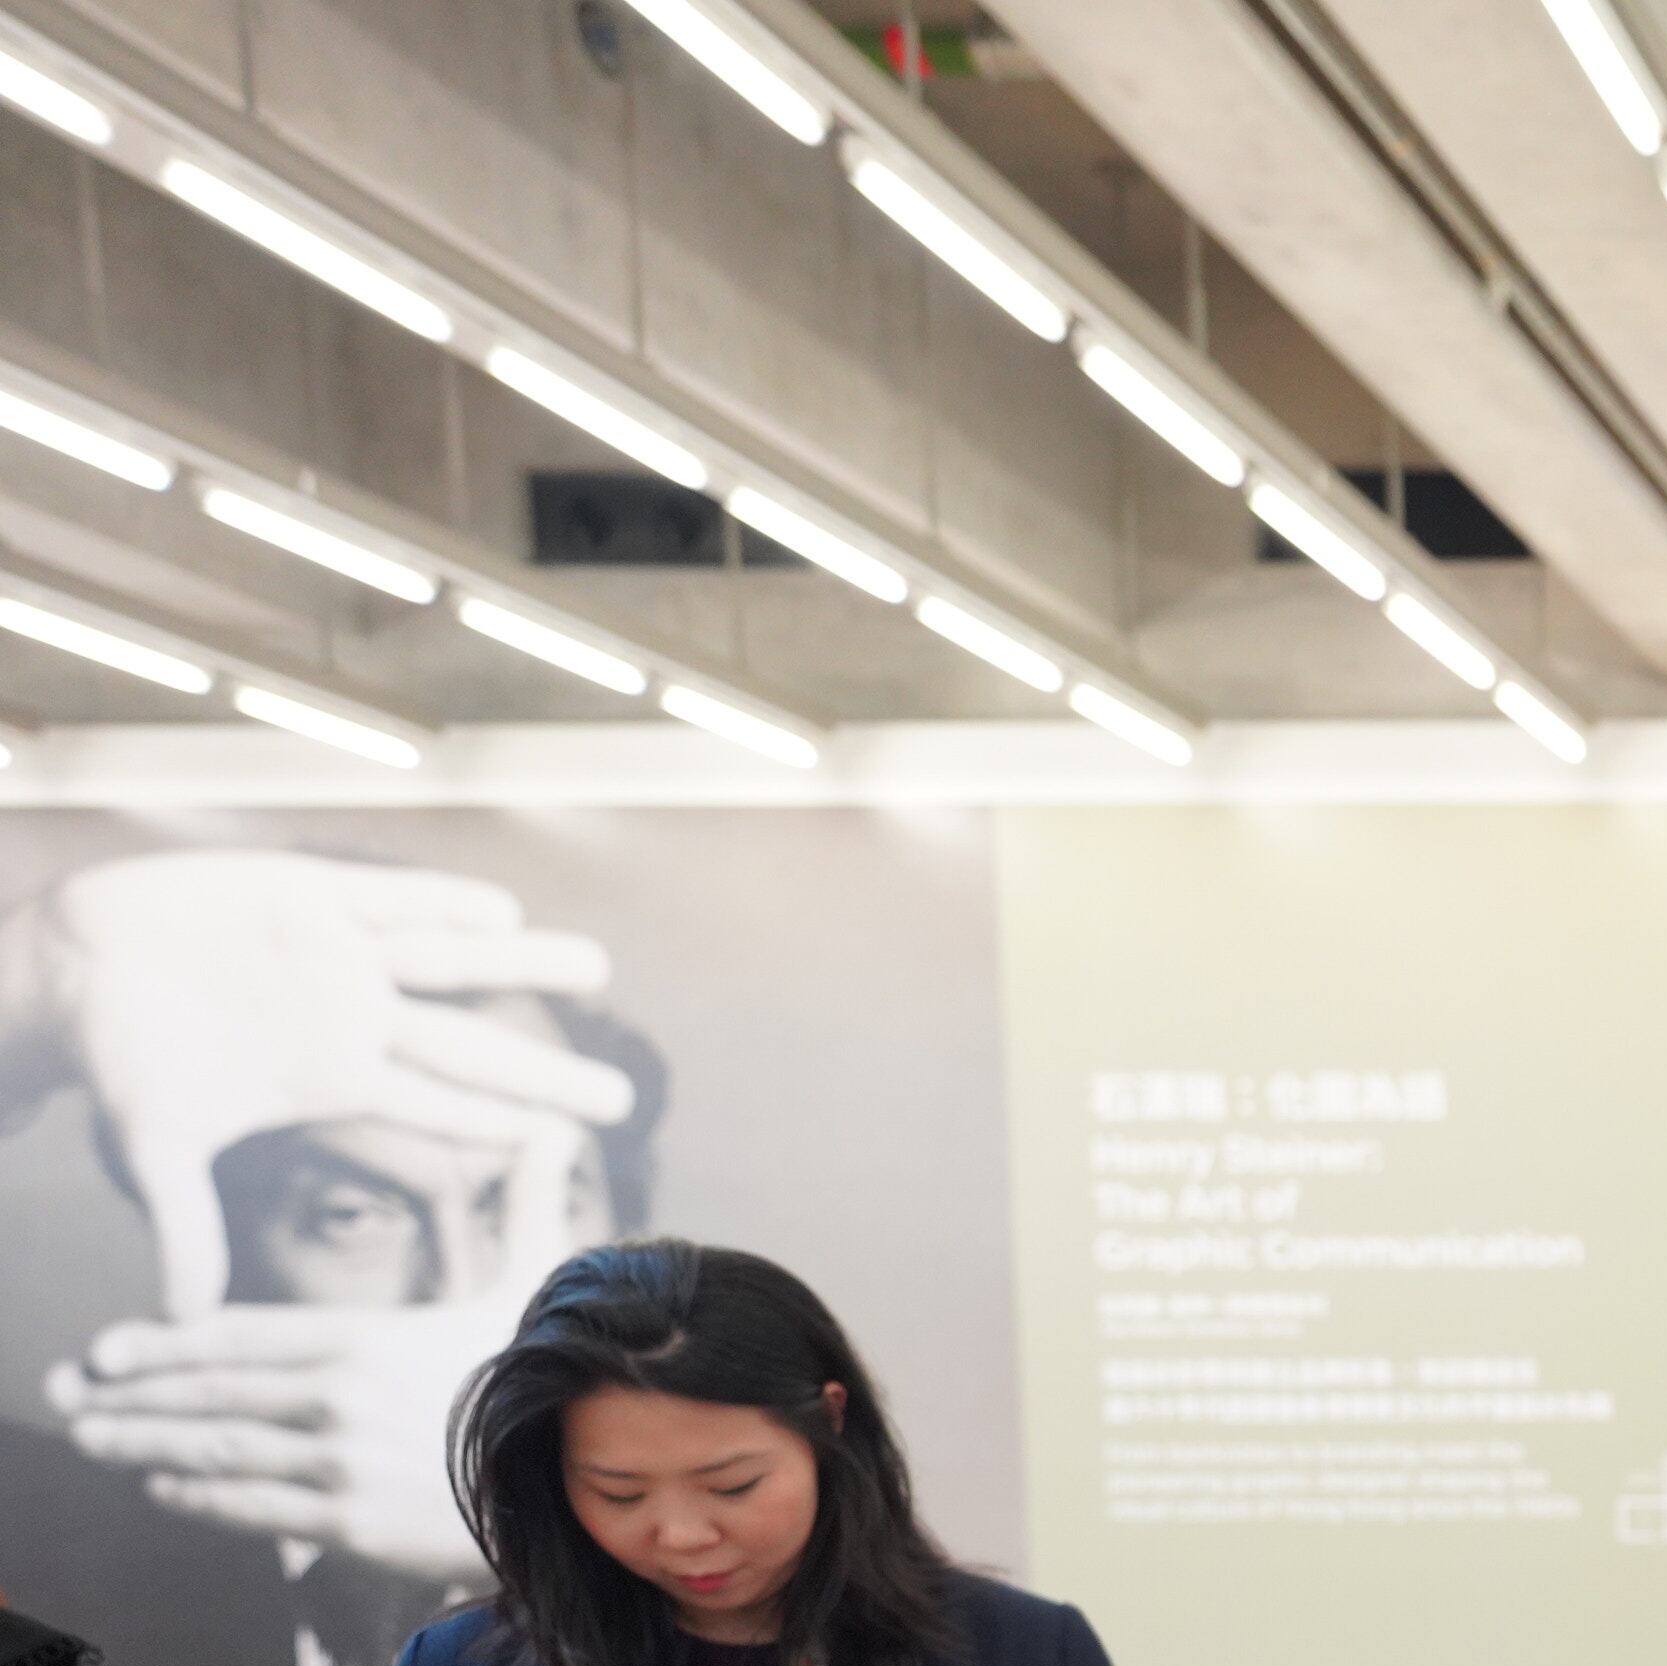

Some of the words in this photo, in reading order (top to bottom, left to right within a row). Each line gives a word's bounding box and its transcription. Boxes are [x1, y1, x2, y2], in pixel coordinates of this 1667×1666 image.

[1092, 1135, 1216, 1178] Henry
[1094, 1179, 1171, 1221] The
[1176, 1178, 1247, 1221] Art
[1253, 1177, 1302, 1220] of
[1094, 1231, 1252, 1275] Graphic
[1261, 1228, 1586, 1269] Communication
